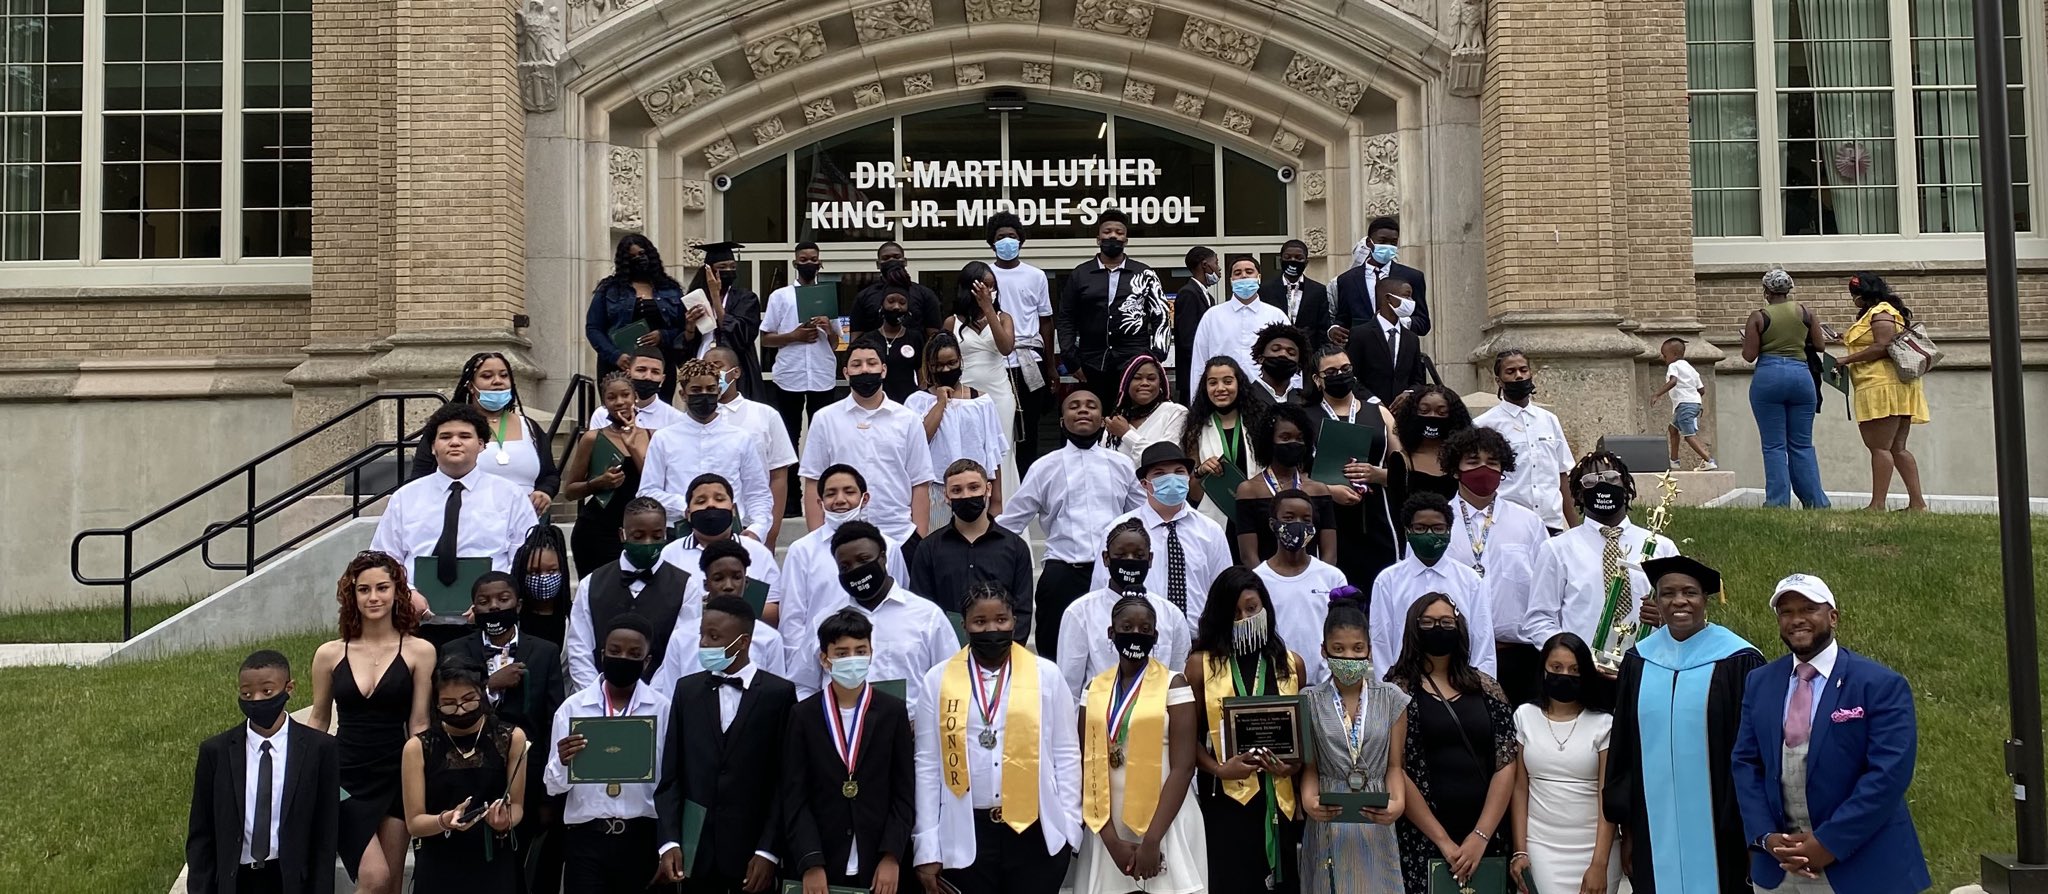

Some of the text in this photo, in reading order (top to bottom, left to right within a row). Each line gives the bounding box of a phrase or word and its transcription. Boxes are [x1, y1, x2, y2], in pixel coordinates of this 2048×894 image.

[855, 158, 1156, 189] DR. MARTIN LUTHER
[811, 200, 895, 231] KING,
[902, 199, 947, 228] JR.
[850, 574, 873, 587] Dream
[1119, 568, 1140, 576] Dream
[857, 583, 870, 591] Big
[946, 698, 960, 786] HONOR
